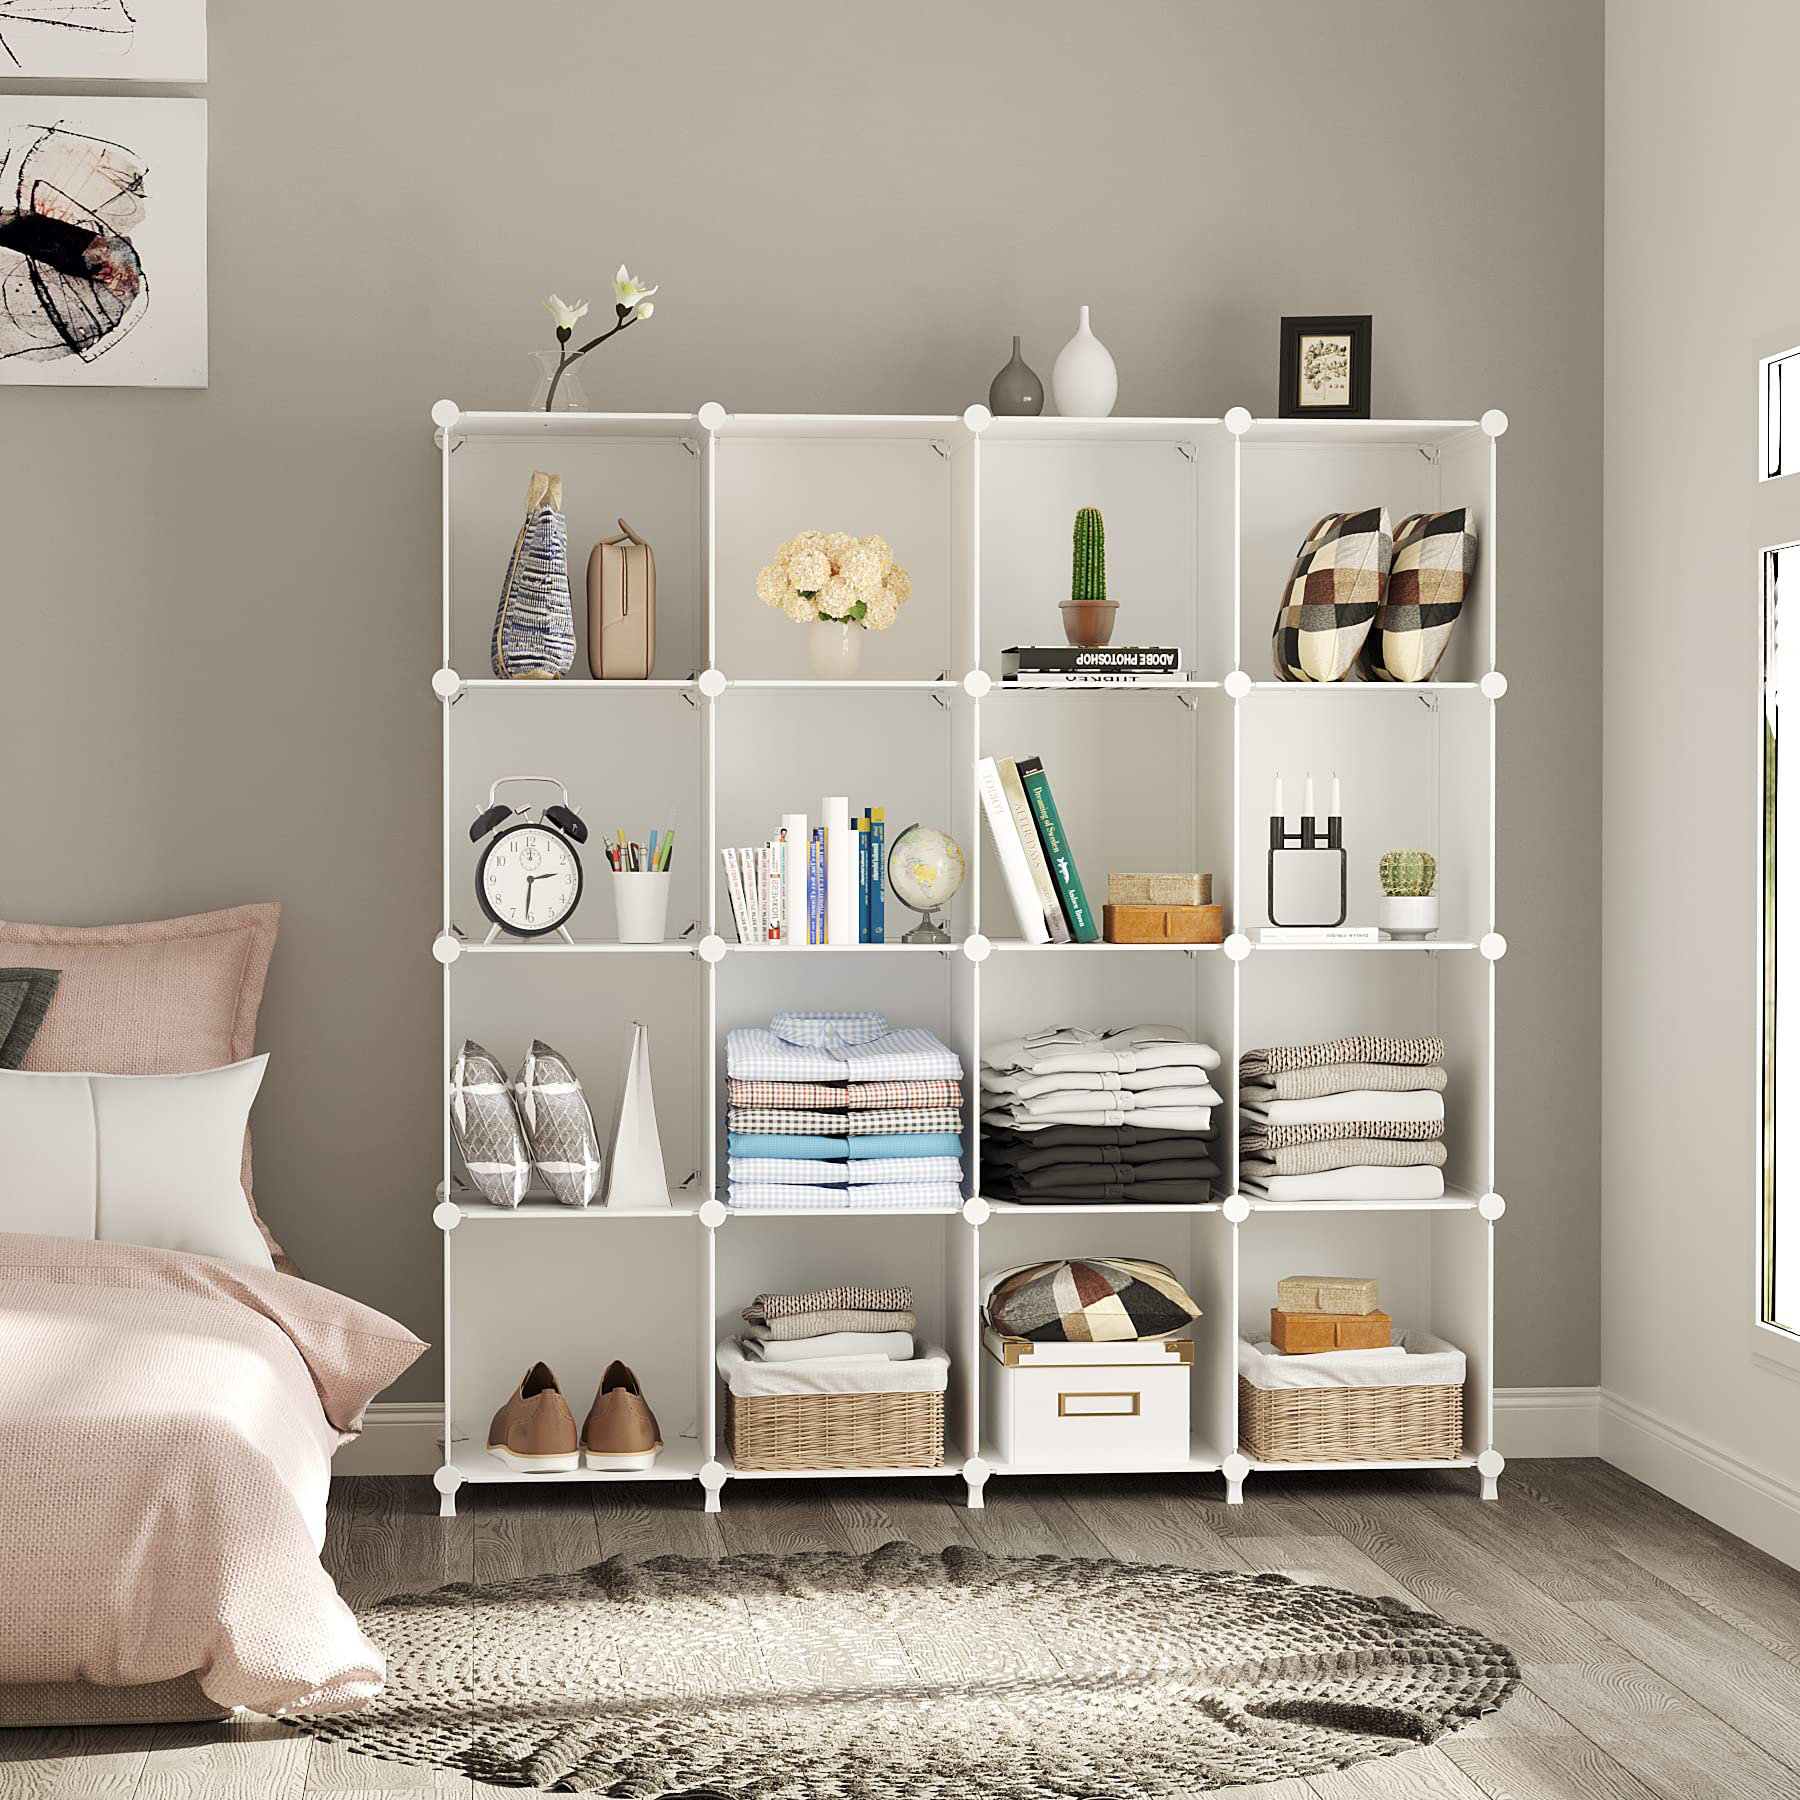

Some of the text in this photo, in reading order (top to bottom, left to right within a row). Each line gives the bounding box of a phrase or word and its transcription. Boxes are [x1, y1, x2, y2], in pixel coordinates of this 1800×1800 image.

[1076, 653, 1174, 665] ADOBE PHOTOSHOP
[1033, 786, 1046, 820] Dreaming
[1048, 825, 1060, 853] Sweden
[510, 841, 518, 852] 11
[526, 836, 536, 847] 12
[547, 840, 550, 852] 1
[496, 855, 506, 867] 10
[560, 855, 566, 865] 2
[489, 875, 497, 886] 9
[565, 874, 572, 885] 3
[495, 894, 502, 904] 8
[560, 894, 566, 904] 4
[510, 907, 517, 918] 7
[548, 907, 555, 918] 5
[1068, 889, 1085, 927] Andrew Brown
[527, 912, 535, 923] 6
